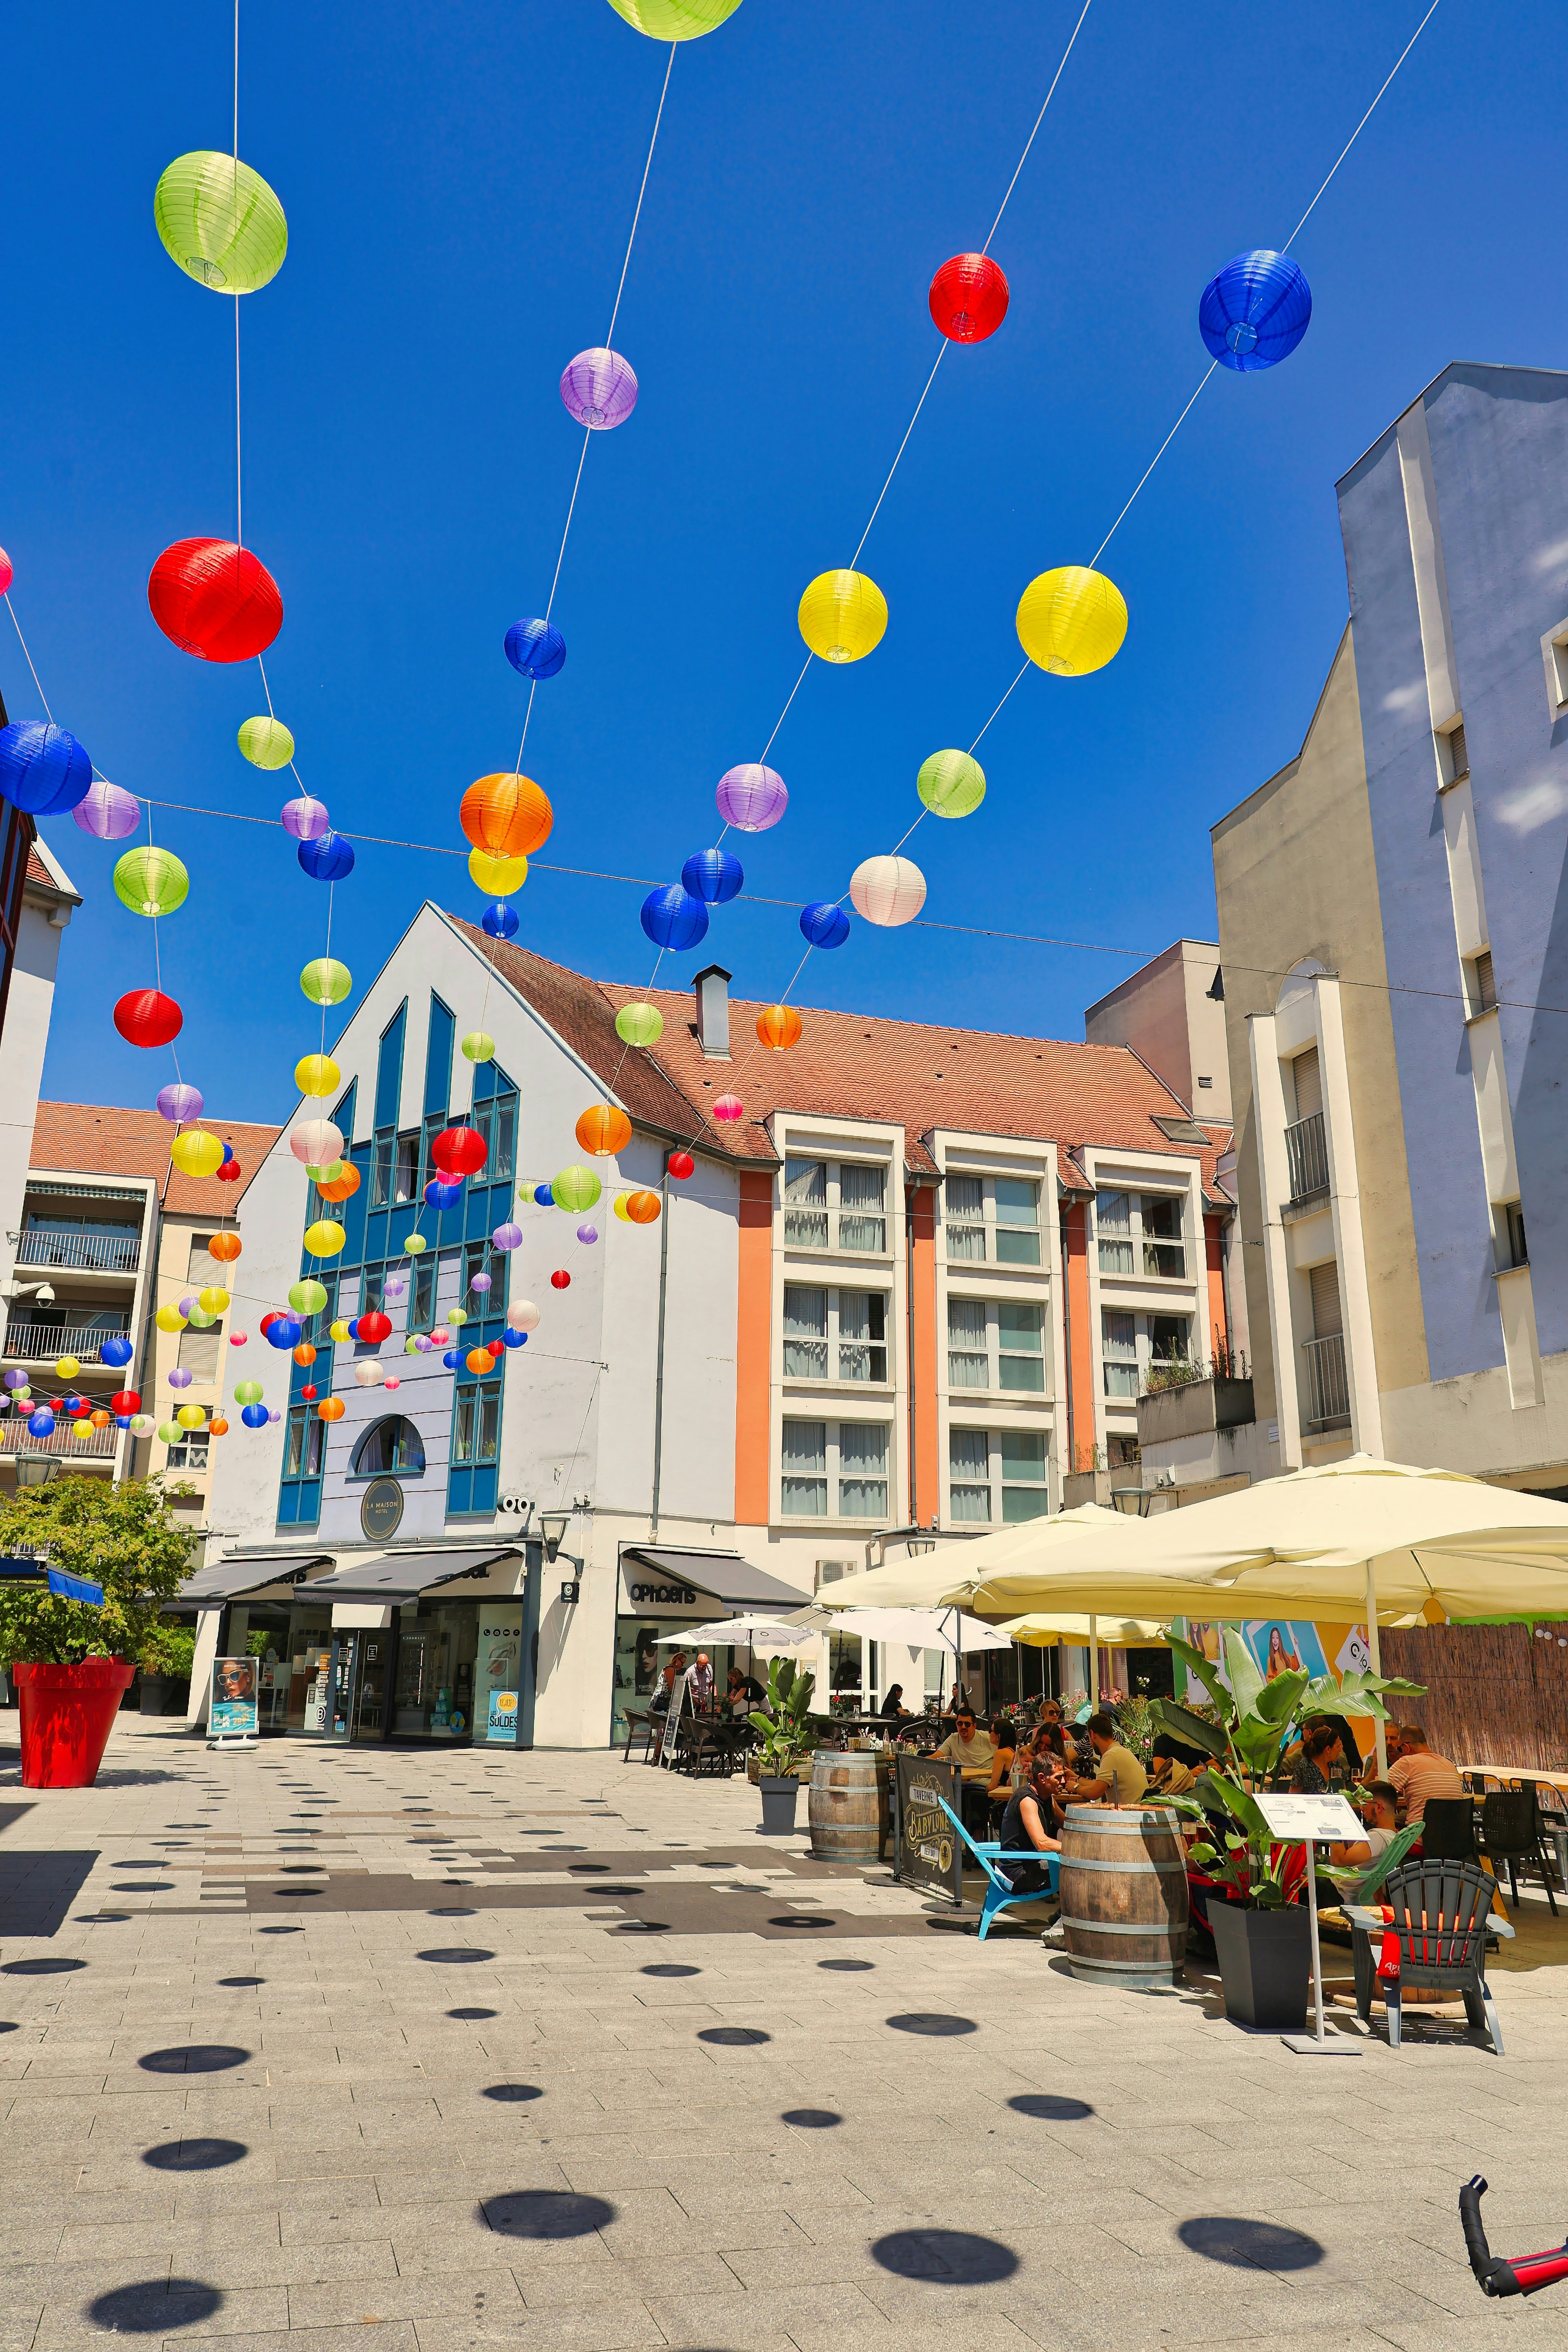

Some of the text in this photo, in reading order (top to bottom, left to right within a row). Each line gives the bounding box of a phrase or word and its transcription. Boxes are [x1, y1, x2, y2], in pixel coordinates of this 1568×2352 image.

[490, 1715, 517, 1728] SOLDES
[913, 1788, 933, 1803] TAVERNE
[909, 1811, 949, 1841] BABYLONE
